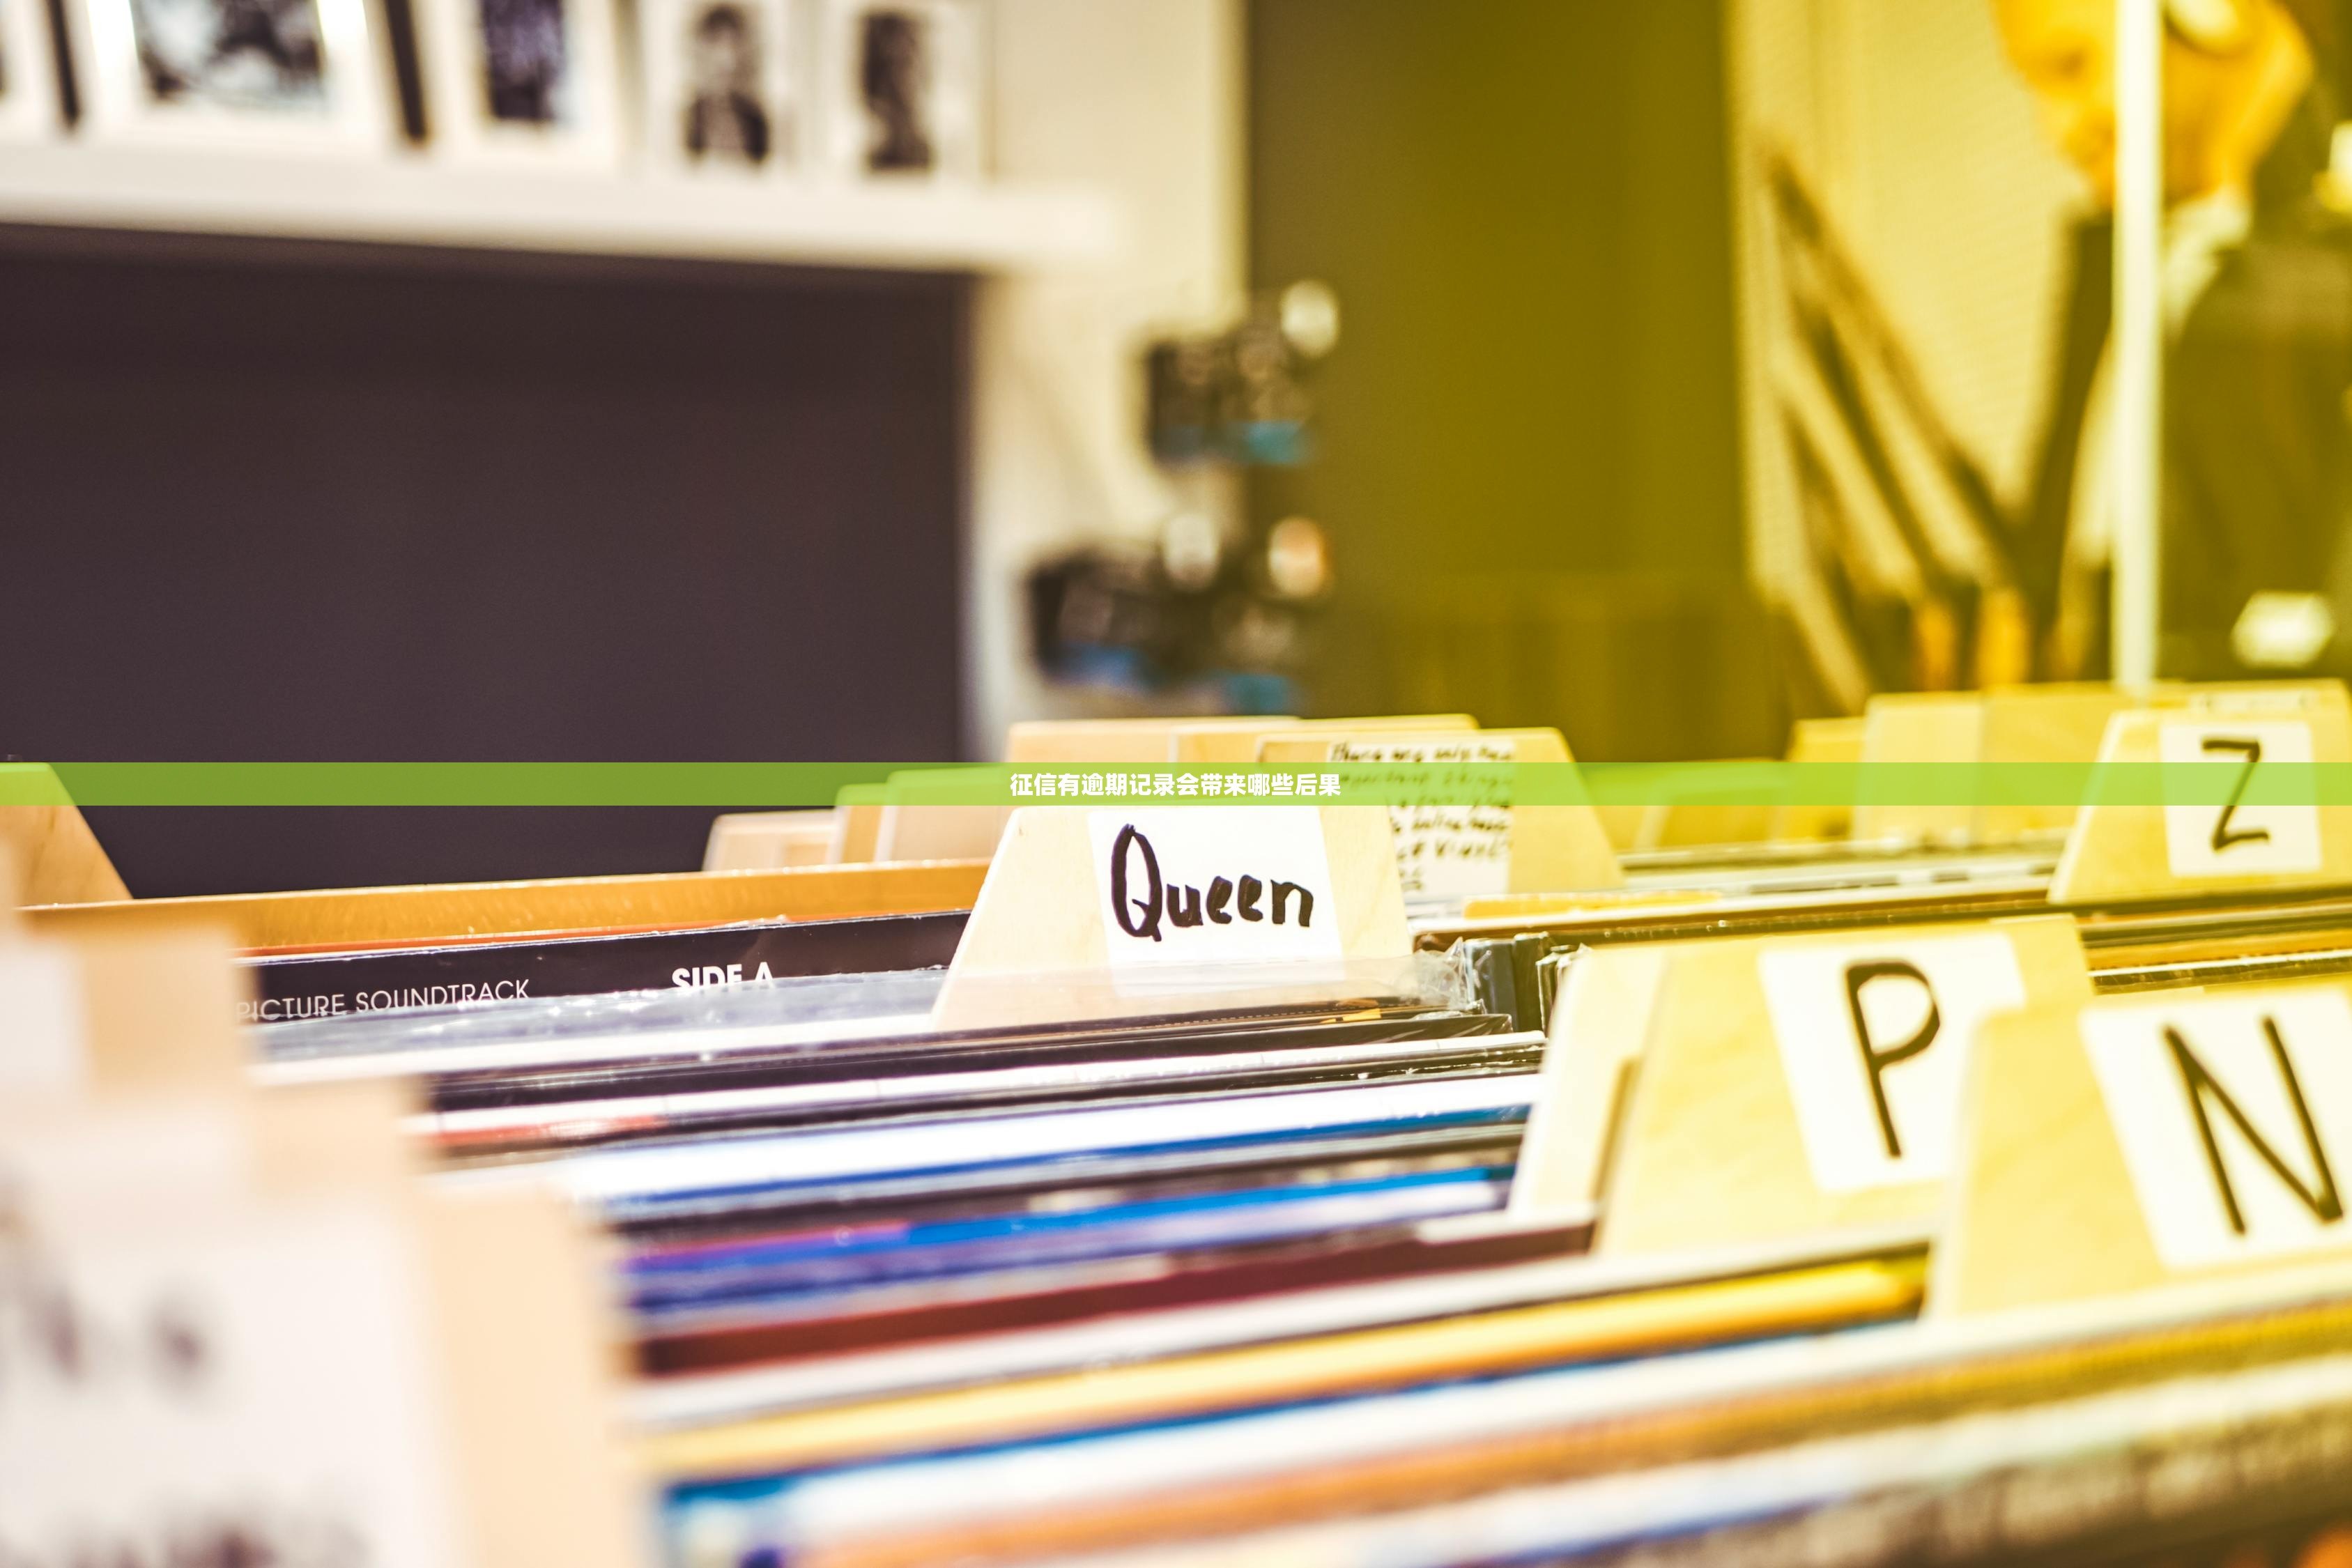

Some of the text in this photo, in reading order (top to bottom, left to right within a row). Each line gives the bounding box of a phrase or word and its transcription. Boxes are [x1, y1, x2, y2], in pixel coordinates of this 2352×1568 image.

[2201, 737, 2270, 852] Z
[1111, 823, 1314, 941] Queen
[236, 978, 530, 1021] PICTURE SOUNDTRACK
[671, 961, 774, 988] SIDE A
[1843, 960, 1942, 1160] P
[2162, 1015, 2344, 1236] N
